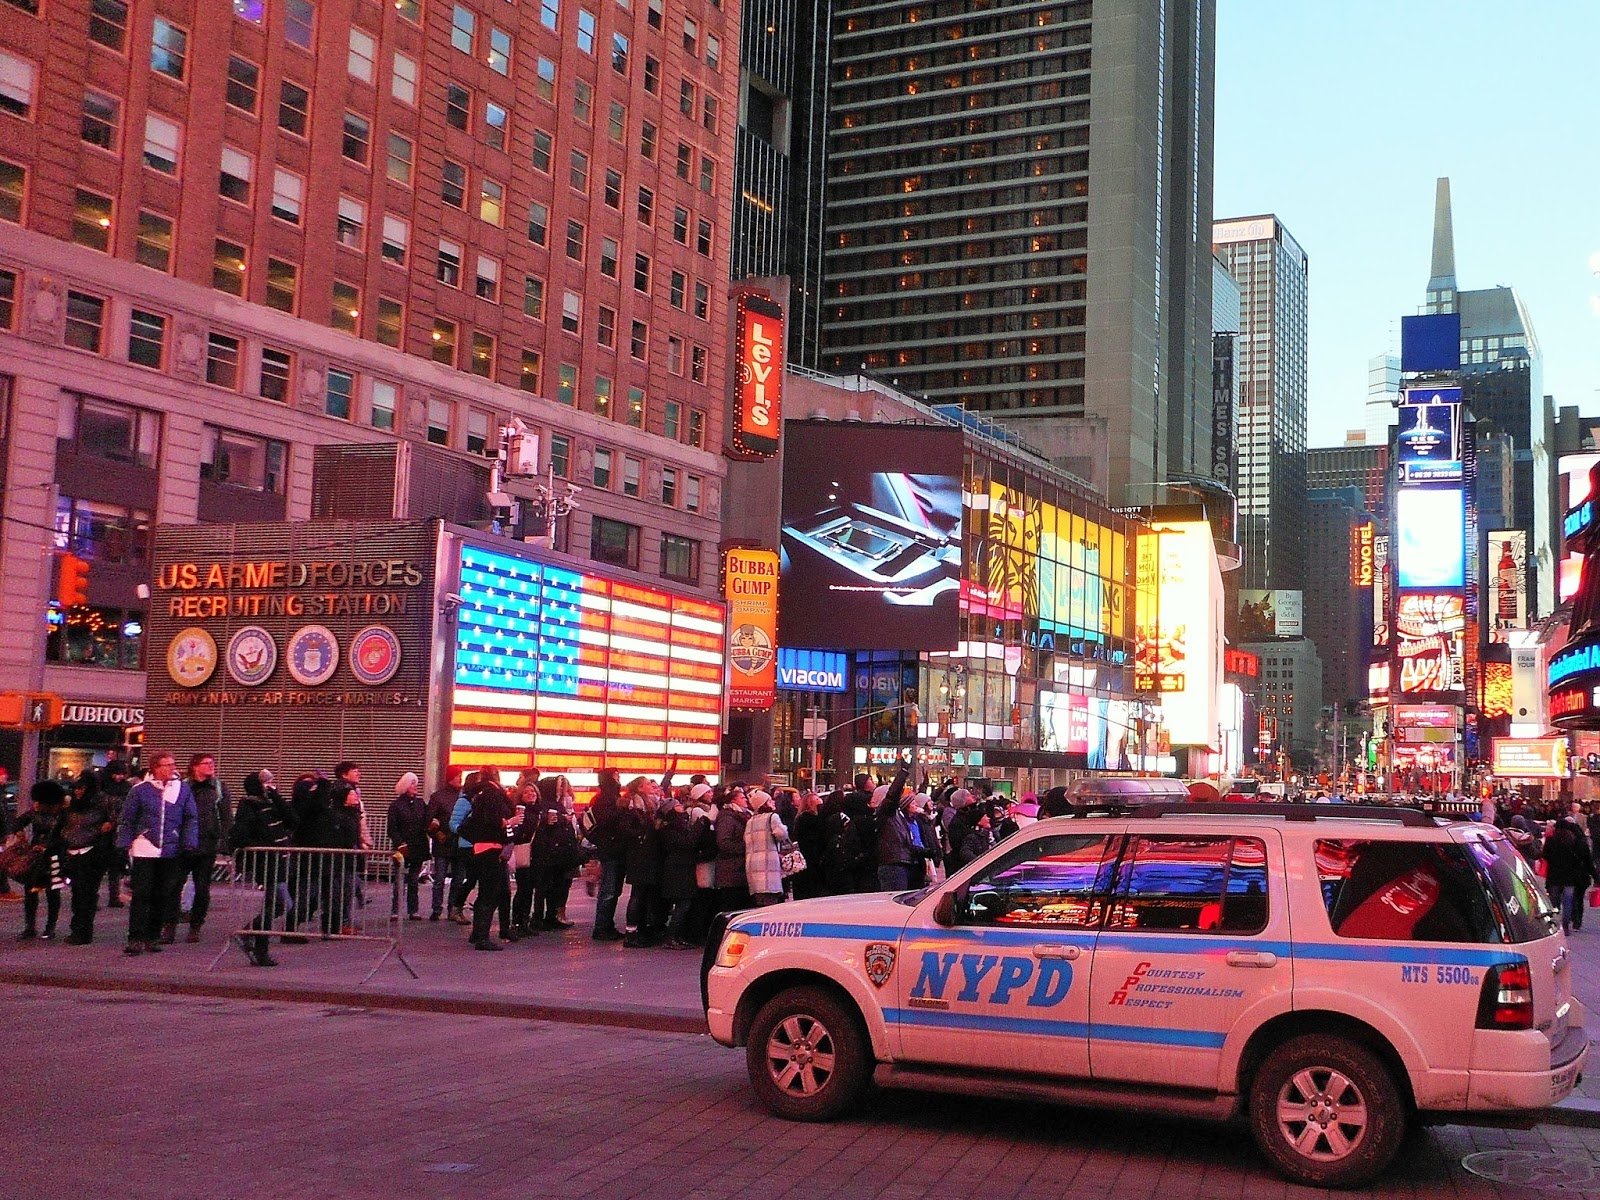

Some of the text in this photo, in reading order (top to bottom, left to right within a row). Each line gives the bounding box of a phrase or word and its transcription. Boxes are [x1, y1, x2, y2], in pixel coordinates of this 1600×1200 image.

[1214, 356, 1230, 437] TIMES
[1359, 521, 1373, 586] NOVOTEL
[158, 559, 424, 590] US ARMED FORCES
[729, 556, 775, 576] BUBBA
[732, 578, 772, 596] GUMP
[169, 592, 408, 618] RECRUITING STATION
[731, 647, 772, 659] UBBA GUMP
[209, 692, 248, 704] NAVY
[262, 691, 283, 704] AIR
[288, 691, 333, 704] FORCE
[344, 691, 402, 704] MARINES
[730, 689, 773, 697] ESTAURANT
[60, 706, 144, 724] LUBHOUS
[761, 922, 803, 938] POLICE
[910, 951, 1074, 1008] NYPD
[1133, 962, 1205, 979] COURTESY
[1402, 965, 1429, 984] MTS
[1120, 976, 1245, 998] PROFESSIONALISM
[1109, 991, 1173, 1009] RESPECT
